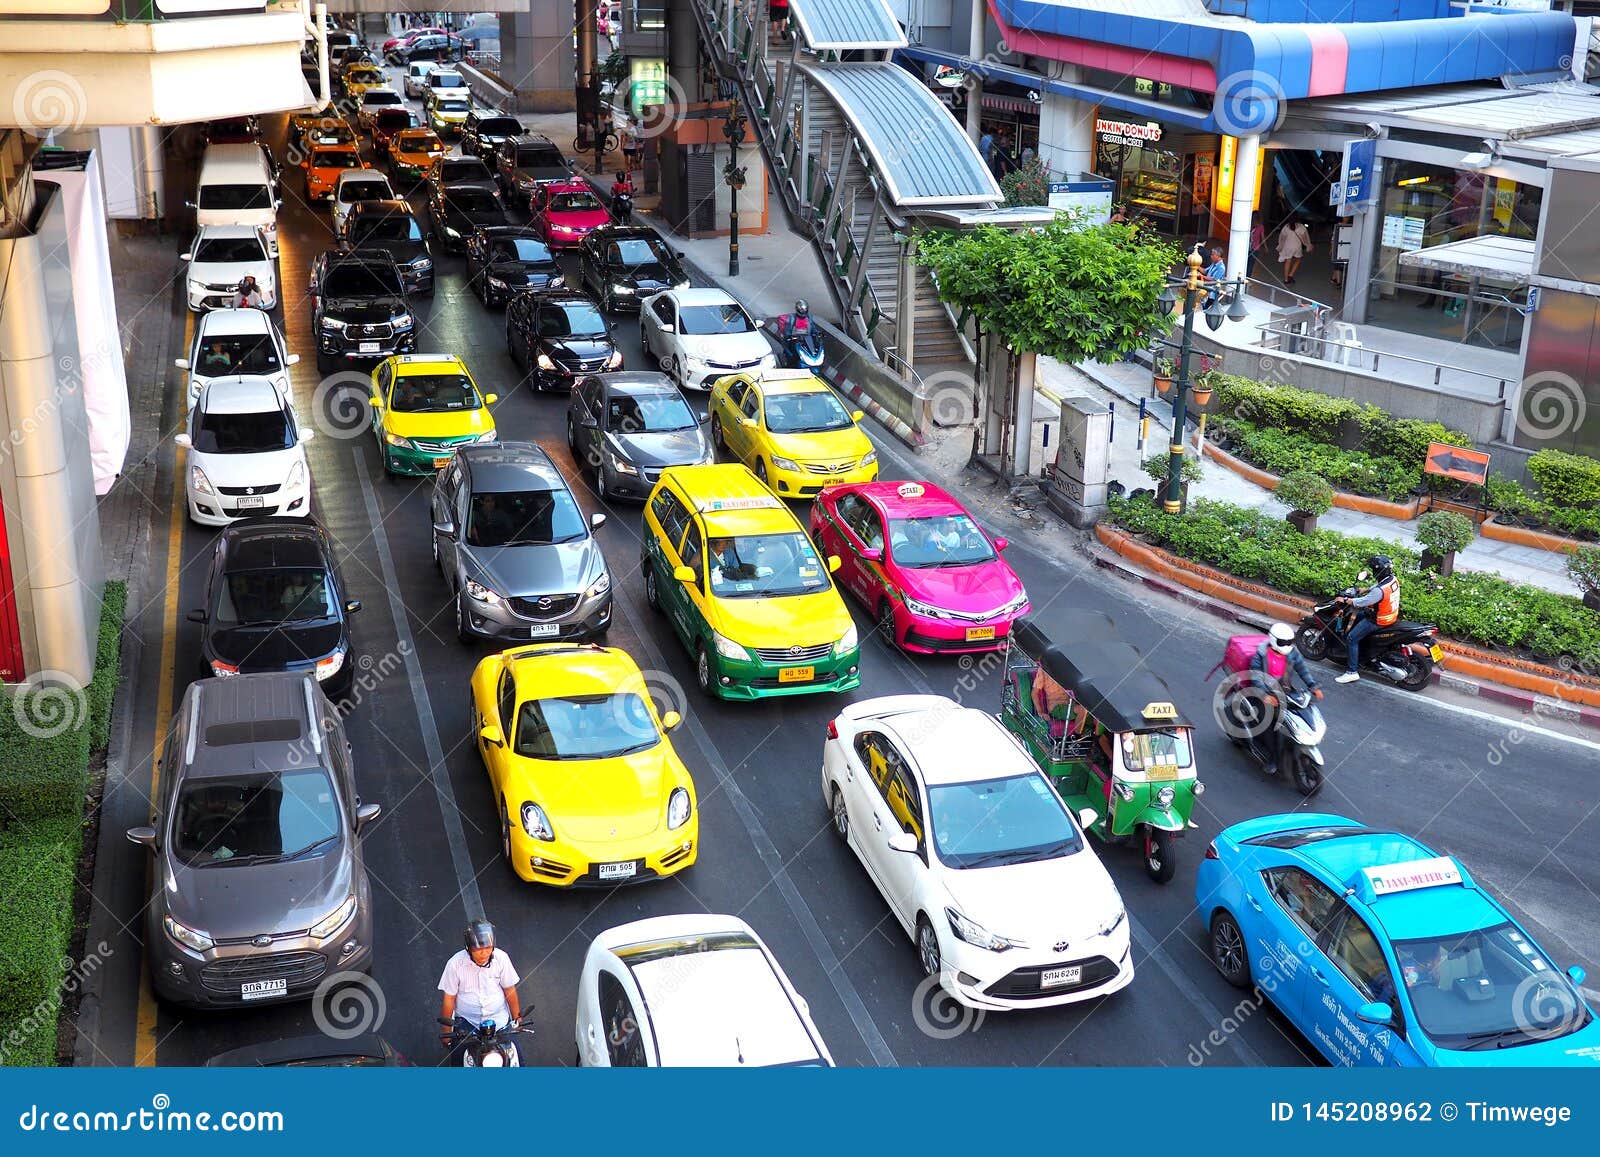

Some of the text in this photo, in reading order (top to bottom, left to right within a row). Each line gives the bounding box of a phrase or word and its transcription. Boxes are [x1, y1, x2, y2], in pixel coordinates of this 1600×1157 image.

[1124, 122, 1162, 141] DONUTS
[1102, 133, 1123, 145] COFFEE
[1127, 138, 1144, 148] MORE
[1151, 706, 1172, 714] TAXI
[619, 862, 633, 871] 505
[1386, 872, 1444, 889] TAXI-METER
[263, 979, 286, 990] 7715
